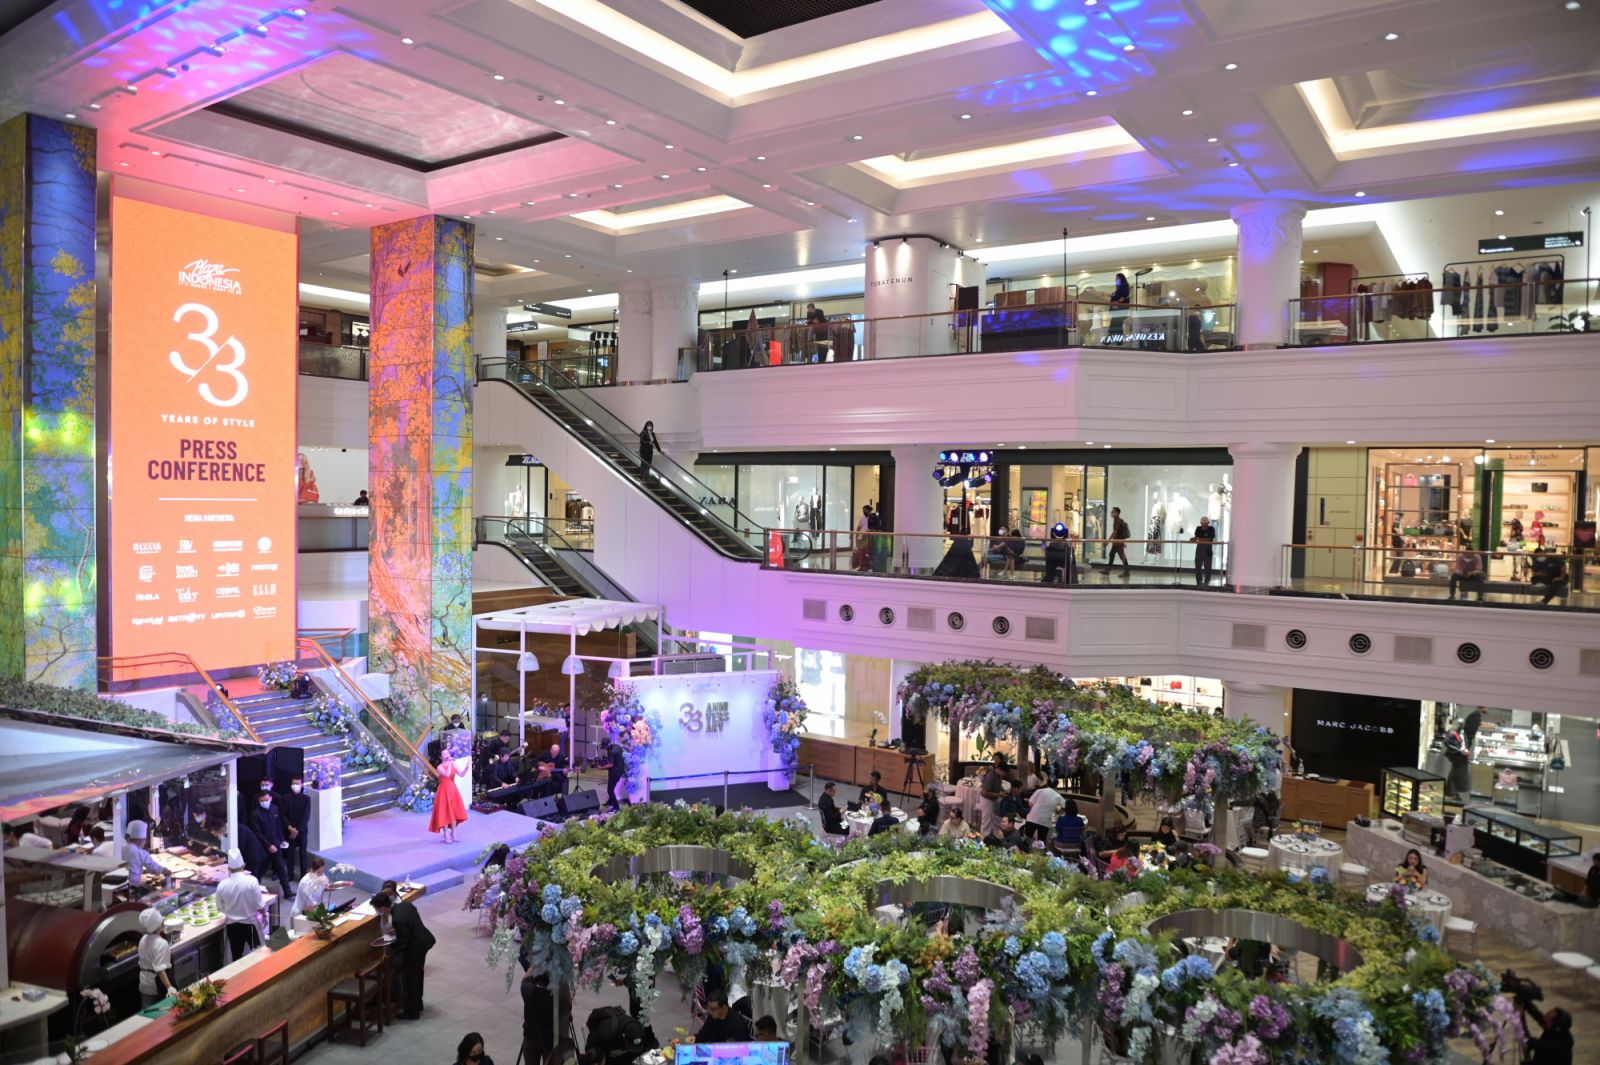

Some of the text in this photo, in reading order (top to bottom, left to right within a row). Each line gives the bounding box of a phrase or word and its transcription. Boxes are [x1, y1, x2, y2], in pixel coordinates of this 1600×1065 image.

[178, 271, 241, 291] INDONESIA
[161, 413, 256, 428] YEARS OF STYLE
[180, 438, 238, 460] PRESS
[147, 460, 267, 483] CONFERENCE
[1316, 719, 1394, 734] MARC JACOBS
